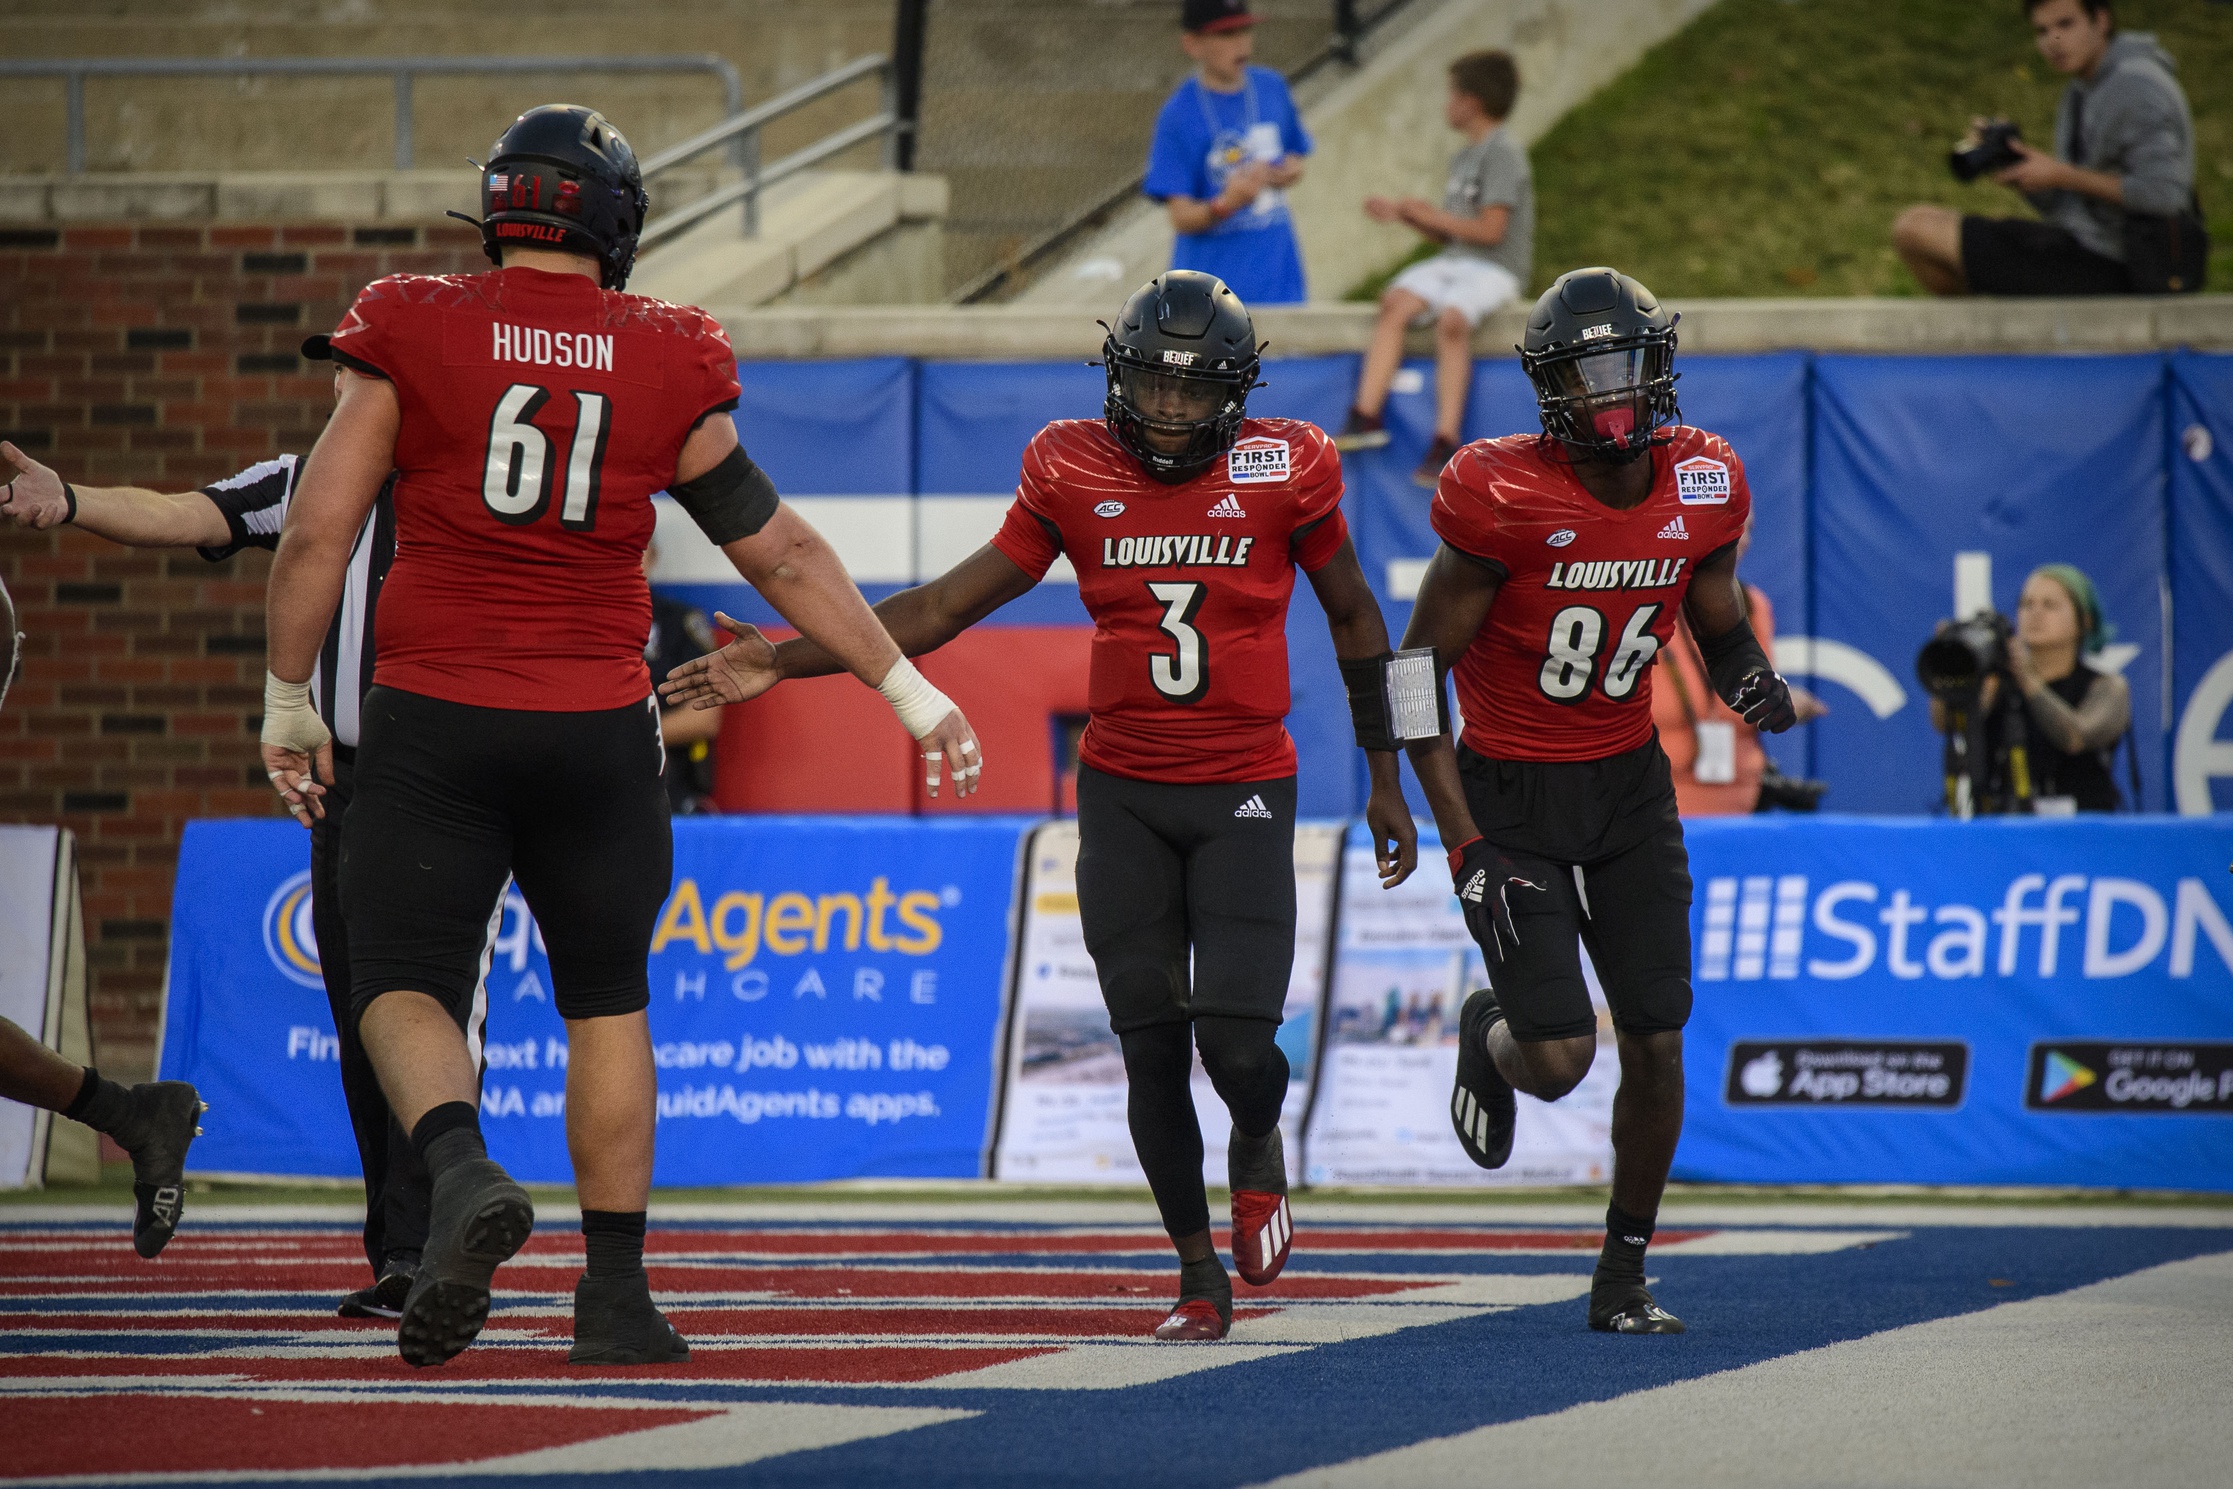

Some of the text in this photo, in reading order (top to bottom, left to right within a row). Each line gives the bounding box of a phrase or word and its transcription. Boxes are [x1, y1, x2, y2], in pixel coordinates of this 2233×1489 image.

[512, 174, 541, 210] 61
[496, 223, 566, 243] LOUISVILLE
[492, 322, 614, 372] HUDSON
[482, 382, 612, 531] 61
[1231, 450, 1286, 464] F1RST
[1231, 463, 1287, 472] RESPONDER
[1679, 472, 1726, 485] F1RST
[1681, 485, 1728, 493] RESPONDER
[1098, 503, 1121, 513] ACC
[1207, 508, 1246, 518] adidas
[1550, 532, 1573, 544] ACC
[1657, 530, 1689, 540] adidas
[1102, 535, 1255, 569] LOUISVILLE
[1545, 558, 1688, 591] LOUISVILLE
[1144, 582, 1207, 702] 3
[1538, 603, 1661, 703] 86
[1234, 809, 1272, 819] adidas
[1461, 868, 1486, 900] adidas
[288, 1026, 340, 1061] Fin
[483, 1038, 538, 1069] ext
[735, 1033, 799, 1074] job
[803, 1037, 882, 1071] with
[889, 1038, 949, 1071] the
[1789, 1069, 1951, 1100] App Store
[2104, 1068, 2216, 1108] Google
[845, 1091, 941, 1126] apps.
